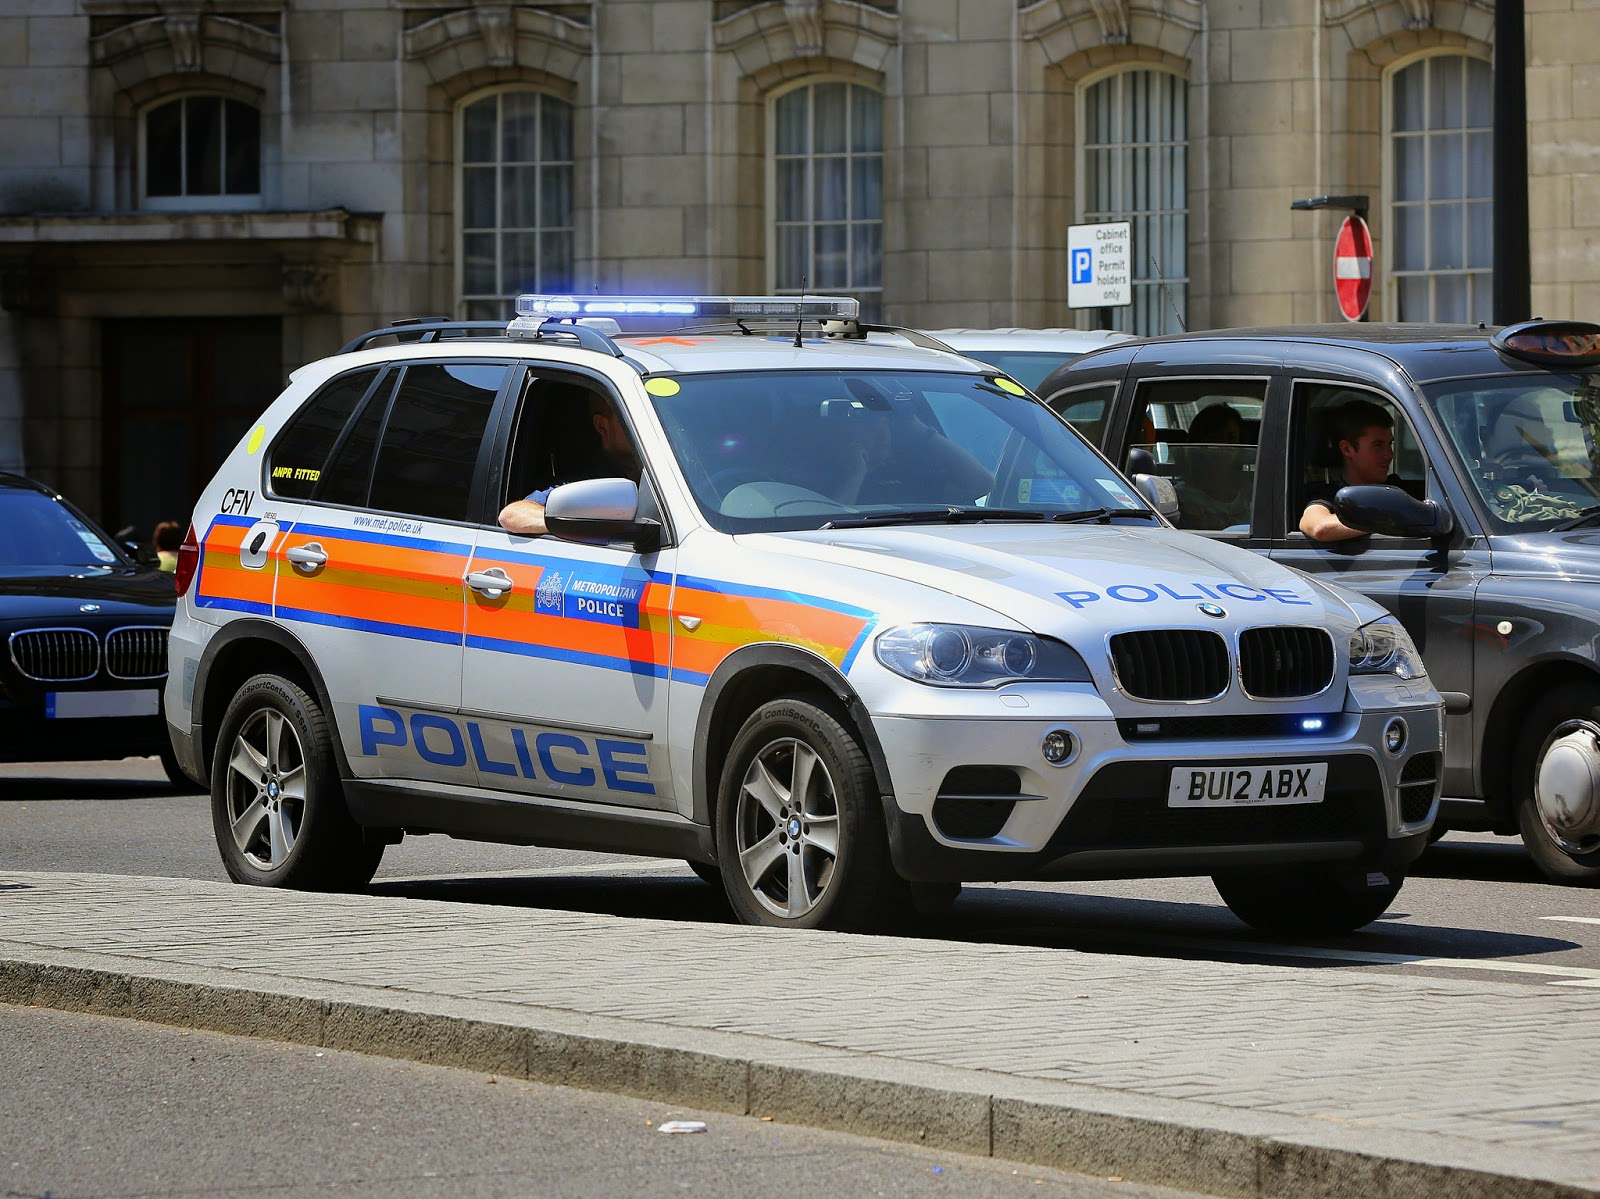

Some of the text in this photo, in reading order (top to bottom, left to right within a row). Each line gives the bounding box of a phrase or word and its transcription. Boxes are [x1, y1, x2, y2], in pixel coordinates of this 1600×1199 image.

[1096, 229, 1127, 240] Cabinet
[1100, 243, 1123, 254] office
[1076, 251, 1090, 282] P
[1099, 260, 1125, 271] Permit
[1097, 275, 1127, 285] holders
[1103, 289, 1121, 301] only
[272, 466, 320, 481] ANPR FITTED
[220, 488, 255, 515] CFN
[353, 516, 423, 534] www.met.police.uk
[572, 580, 637, 599] METROPOLITAN
[1053, 583, 1313, 609] POLICE
[578, 597, 624, 617] POLICE
[765, 708, 841, 769] ContiSportContact
[358, 704, 656, 796] POLICE
[1188, 768, 1311, 800] BU12 ABX
